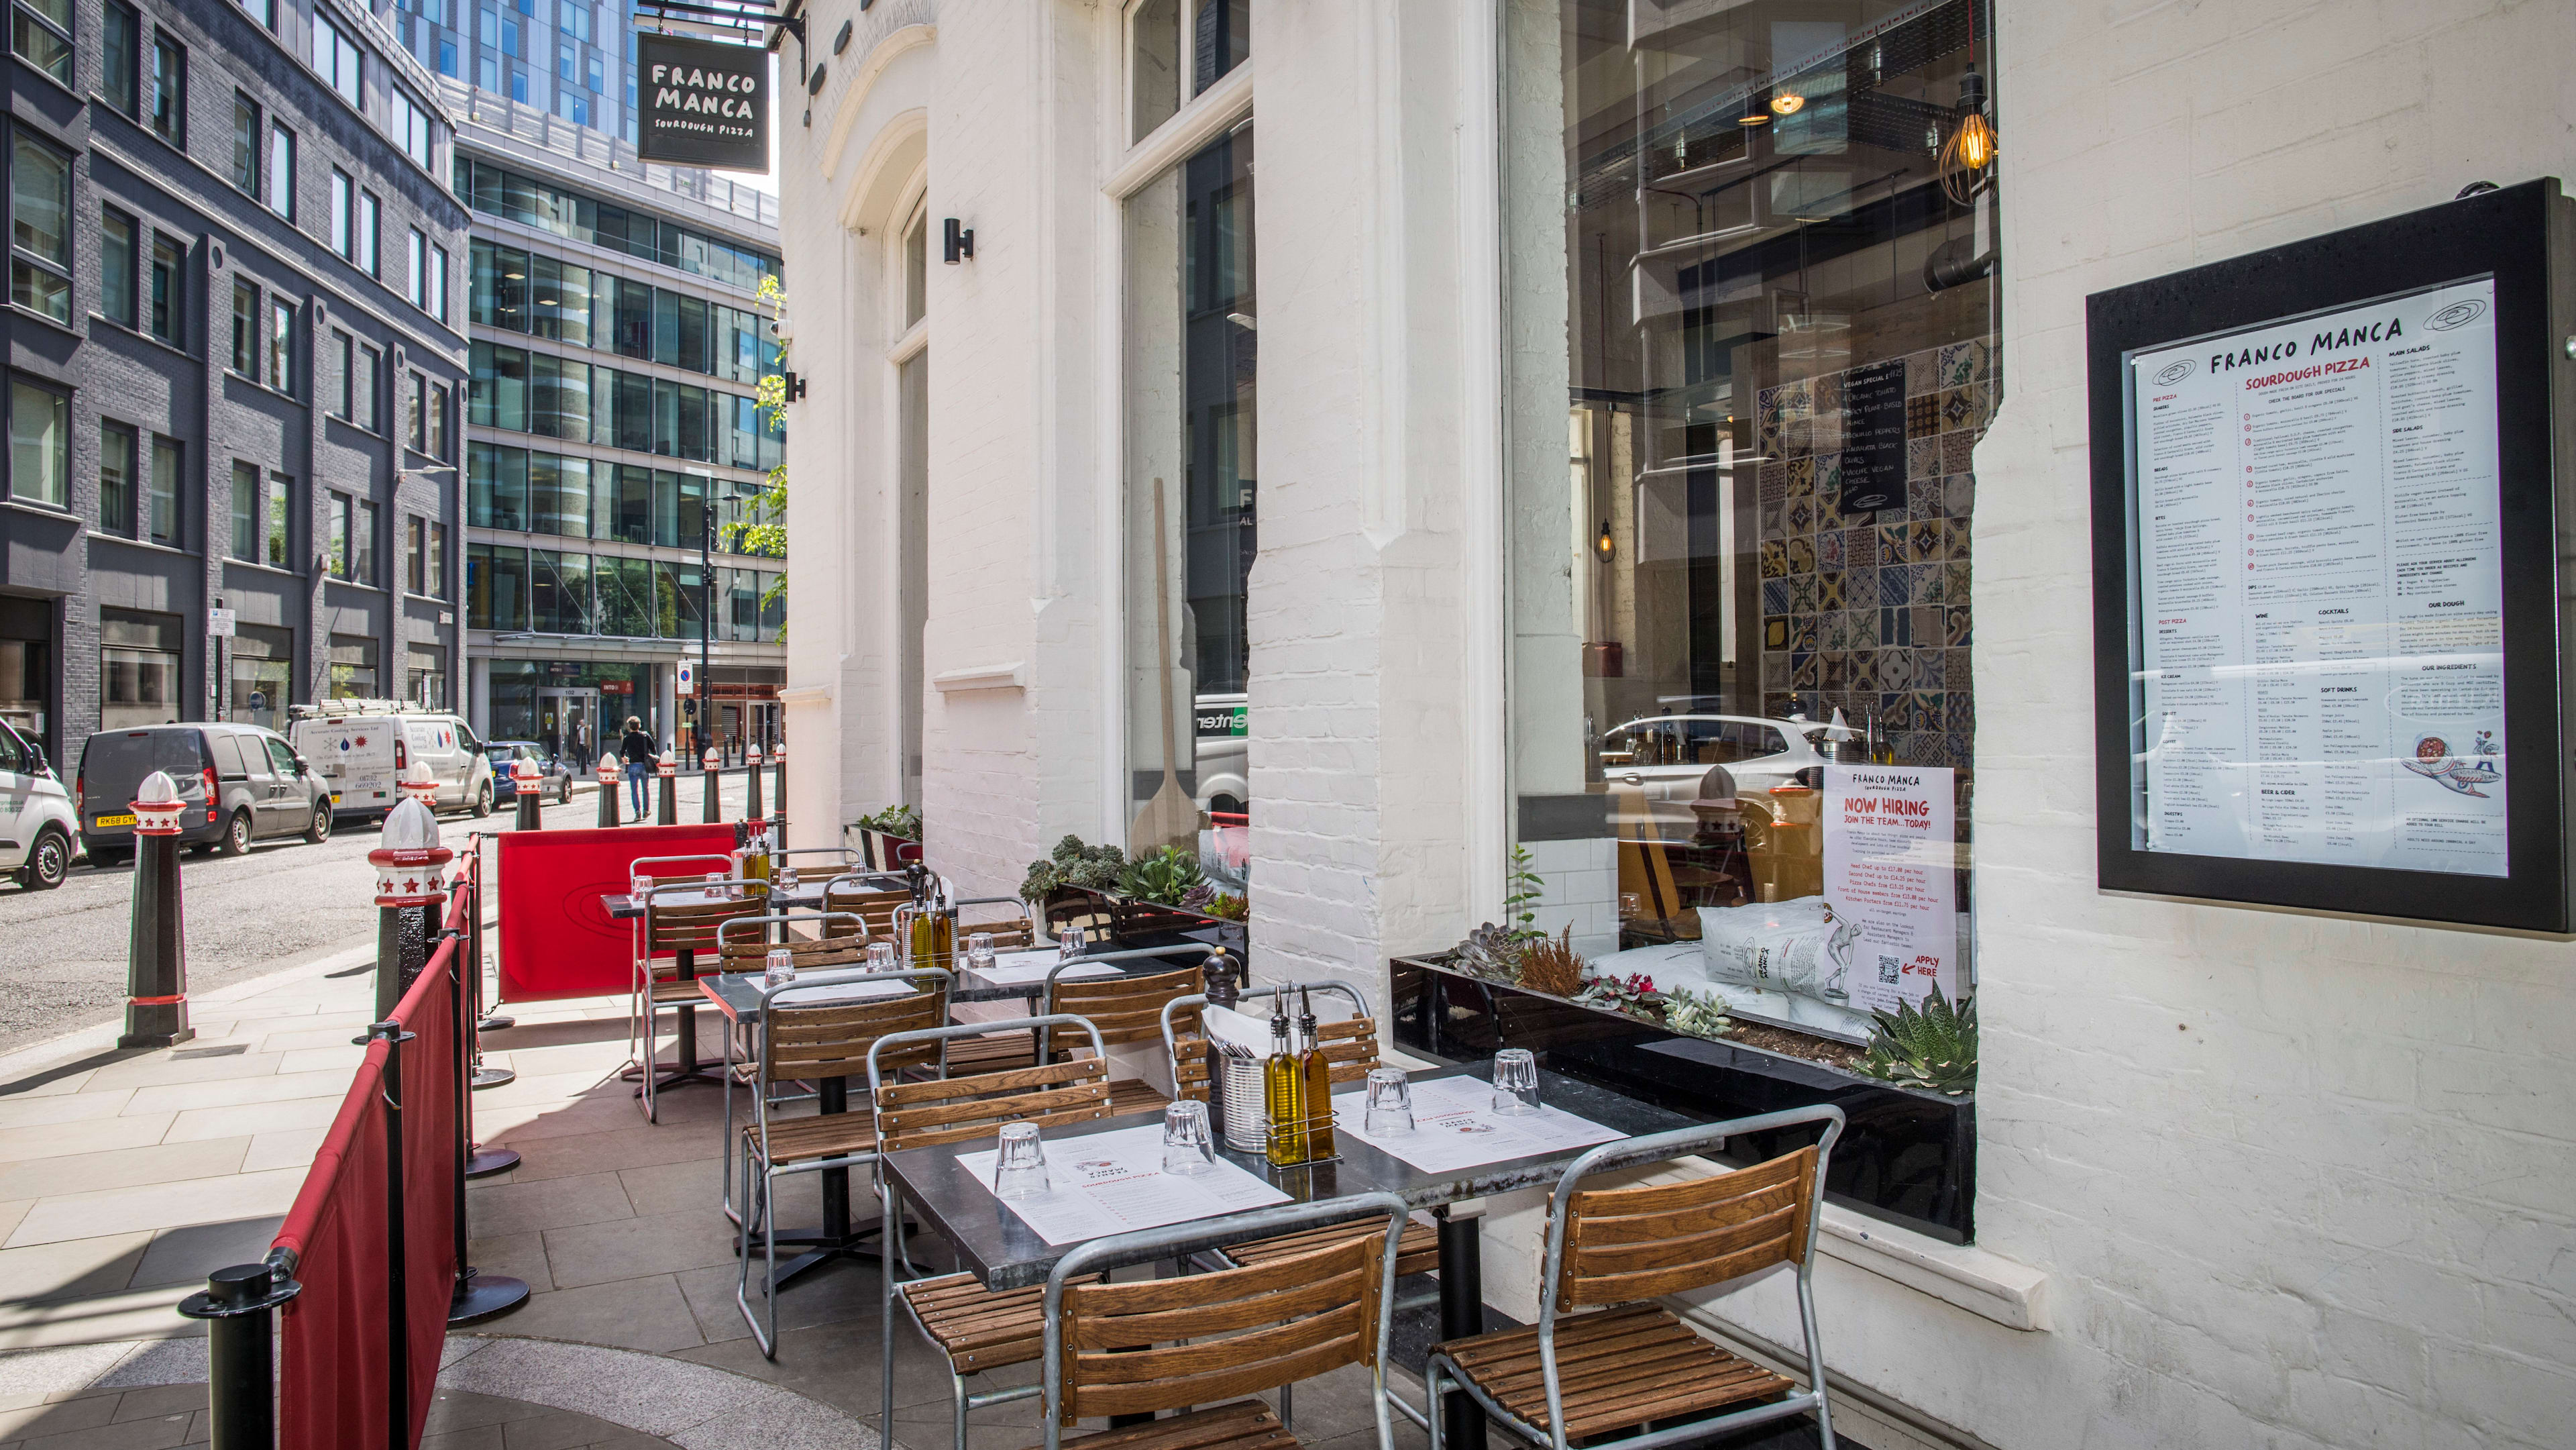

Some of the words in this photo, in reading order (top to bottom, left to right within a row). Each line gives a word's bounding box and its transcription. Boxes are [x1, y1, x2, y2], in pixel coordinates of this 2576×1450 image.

[652, 64, 755, 93] FRANCO
[655, 87, 753, 119] MANCA
[655, 119, 714, 133] SOURDOUGH
[719, 125, 753, 138] PIZZA
[2212, 342, 2296, 374] FRANCO
[2311, 318, 2402, 356] MANCA
[2406, 345, 2430, 354] SALADS
[2246, 364, 2320, 390] SOURDOUGH
[2325, 357, 2370, 375] PIZZA
[1864, 376, 1884, 384] SPECIAL
[1853, 774, 1884, 783] FRANCO
[1888, 775, 1919, 786] MANCA
[1845, 797, 1877, 813] NOW
[1882, 797, 1930, 816] HIRING
[100, 816, 120, 825] RK68
[1844, 815, 1858, 823] JOIN
[1861, 816, 1874, 824] THE
[1915, 955, 1939, 968] APPLY
[1917, 966, 1937, 977] HERE
[1081, 1176, 1132, 1188] SOURDOUGH
